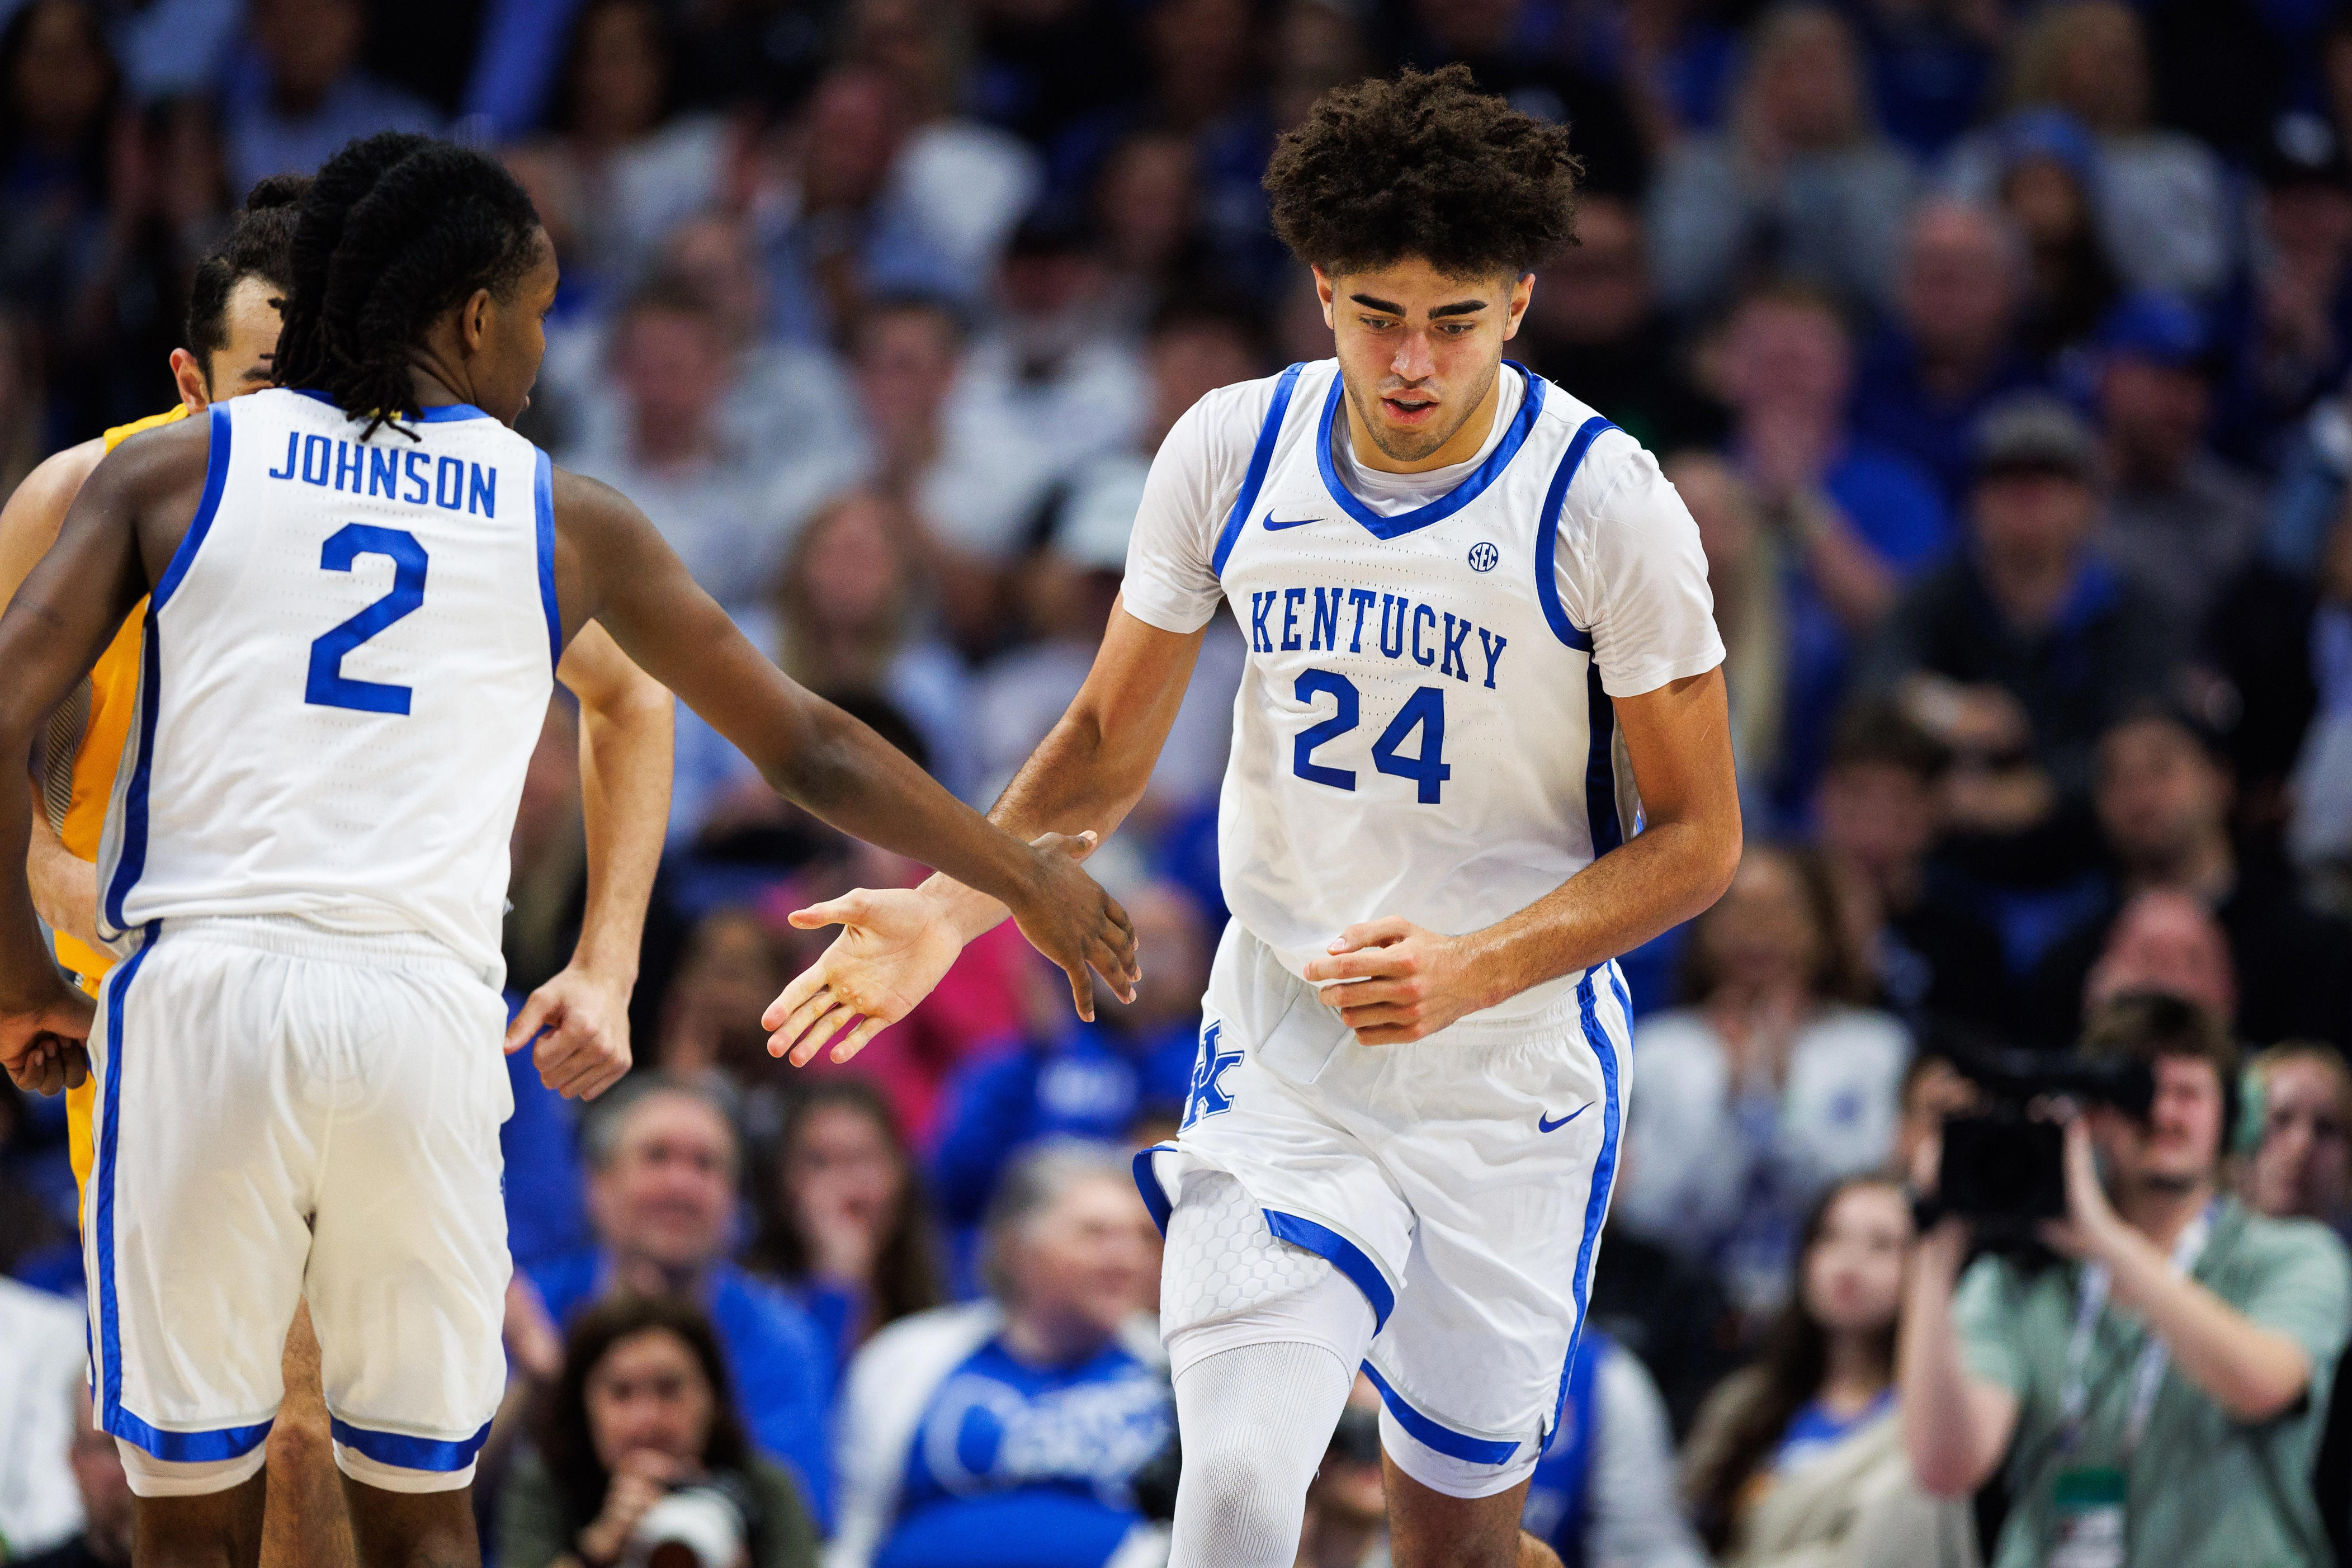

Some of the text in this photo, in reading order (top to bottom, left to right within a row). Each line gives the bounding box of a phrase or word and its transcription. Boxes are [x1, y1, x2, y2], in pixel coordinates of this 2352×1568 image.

[269, 431, 497, 519] JOHNSON
[1470, 543, 1497, 571] SEC
[305, 522, 429, 716] 2
[1252, 587, 1507, 689] KENTUCKY
[1293, 668, 1451, 804] 24
